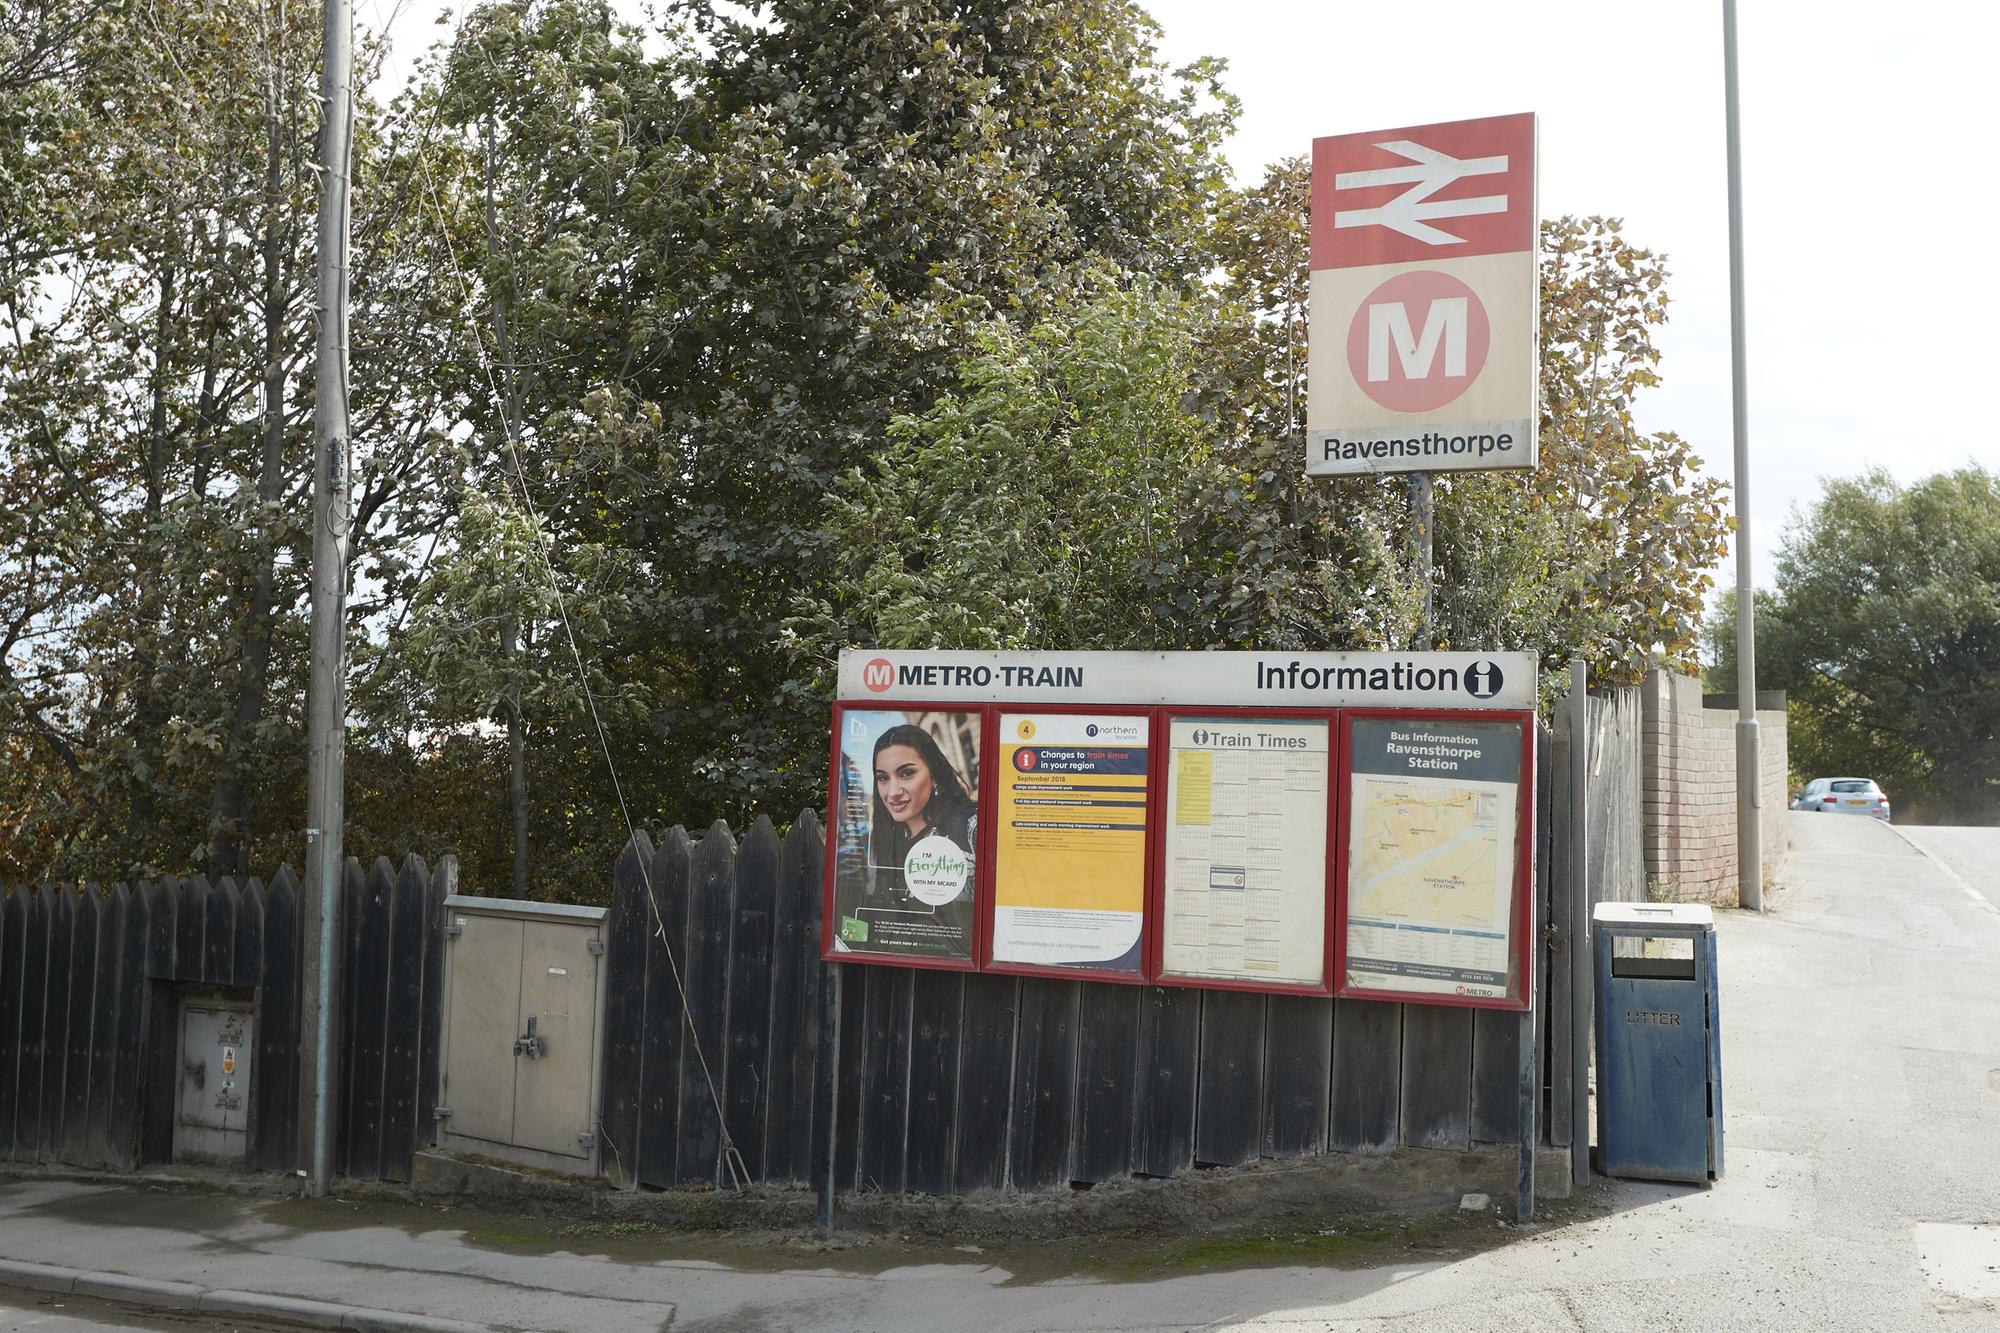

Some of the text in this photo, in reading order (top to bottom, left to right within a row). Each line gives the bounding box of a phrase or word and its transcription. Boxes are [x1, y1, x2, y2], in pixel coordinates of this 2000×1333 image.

[1367, 296, 1468, 382] M
[1324, 432, 1513, 460] Ravensthorpe
[1258, 661, 1458, 690] Information
[1100, 726, 1137, 734] northern
[1210, 733, 1252, 747] Train
[1257, 734, 1307, 748] Times
[1390, 732, 1478, 745] Bus Information
[1041, 751, 1075, 760] Changes
[1386, 743, 1482, 760] Ravensthorpe
[1070, 762, 1095, 770] region
[1408, 757, 1458, 770] Station
[908, 854, 964, 876] Everything
[1627, 1011, 1681, 1026] LITTER
